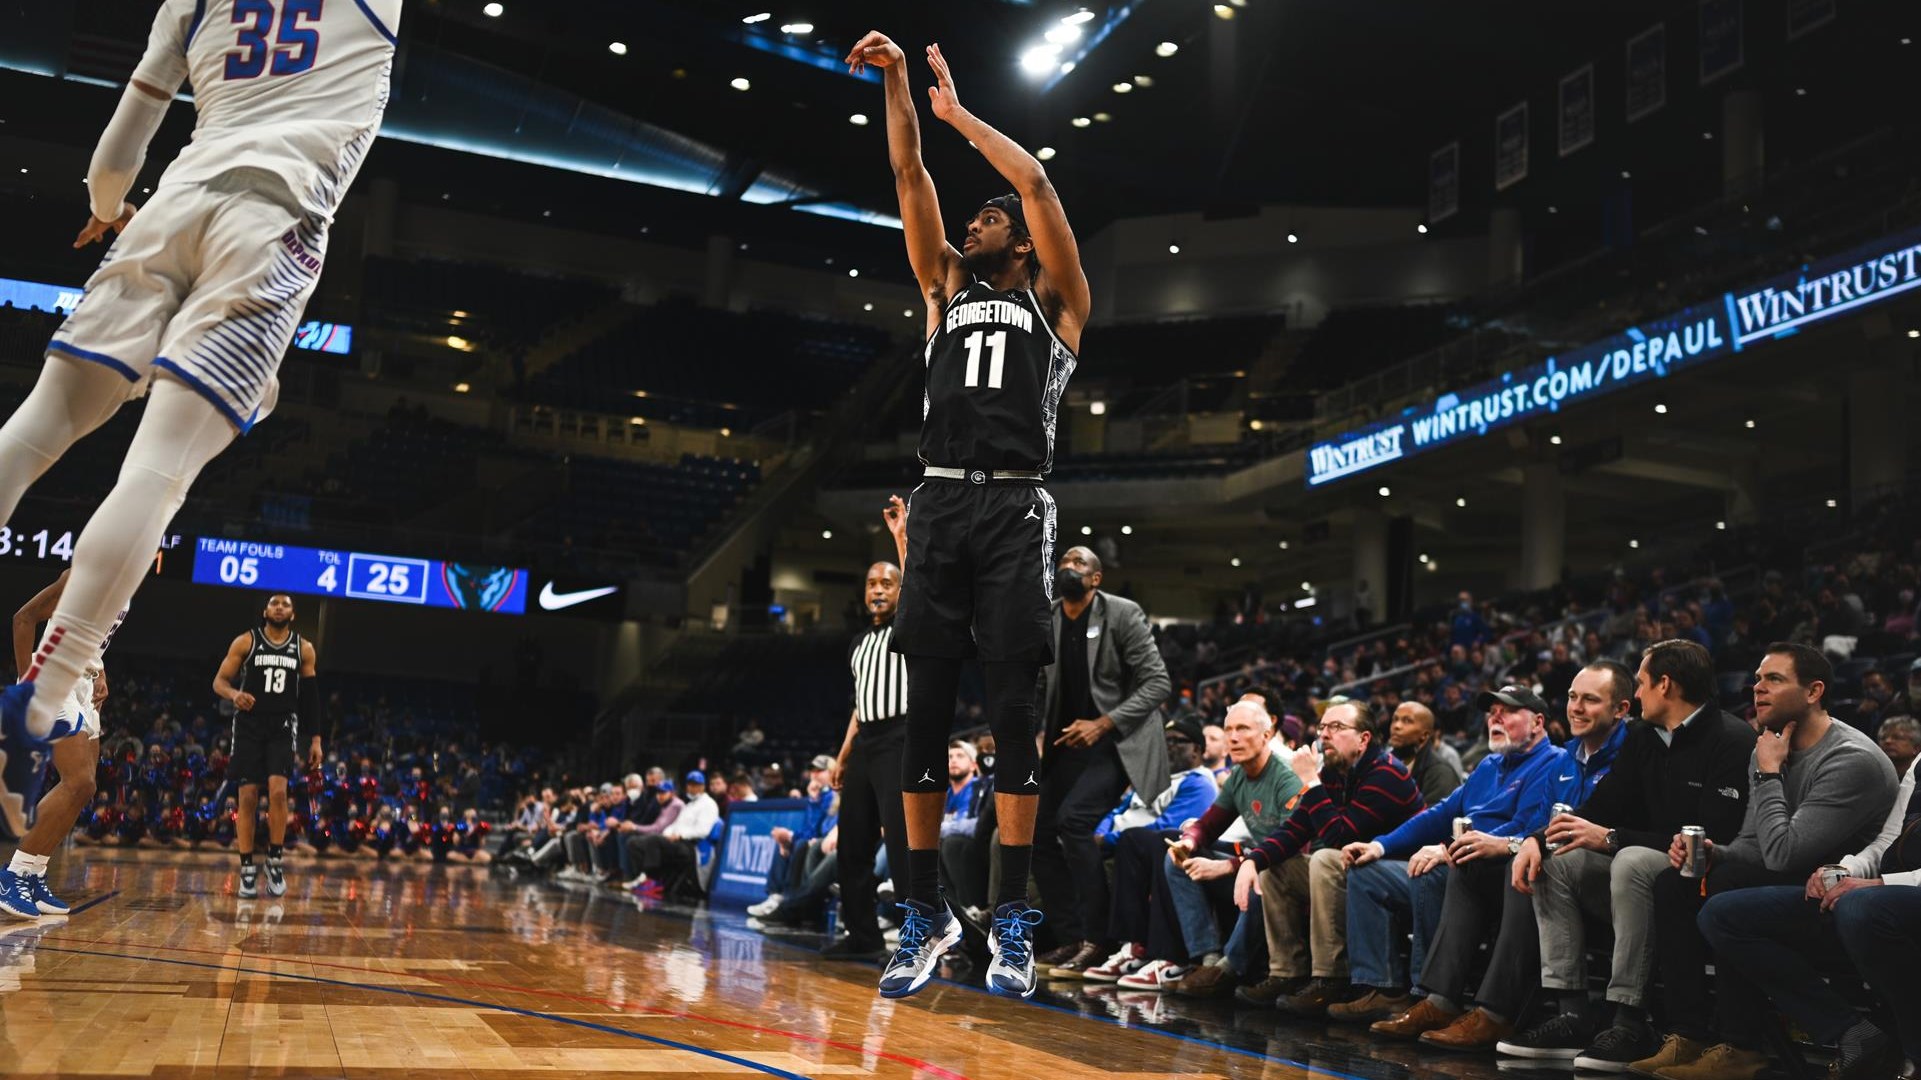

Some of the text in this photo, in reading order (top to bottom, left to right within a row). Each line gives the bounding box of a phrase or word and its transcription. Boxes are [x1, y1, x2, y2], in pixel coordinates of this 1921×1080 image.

[224, 0, 324, 80] 35
[1737, 243, 1921, 332] WINTRUST
[946, 300, 1033, 334] GEORGETOWN
[964, 330, 1007, 389] 11
[1310, 318, 1723, 475] WINTRUST WINTRUST.COM/DEPAUL
[199, 537, 285, 559] TEAM FOULS
[318, 551, 341, 565] TOL
[219, 555, 259, 585] 05
[316, 565, 338, 592] 4
[366, 563, 410, 595] 25
[254, 654, 298, 670] GEORGETOWN
[263, 667, 287, 694] 13
[727, 825, 776, 874] WINTR
